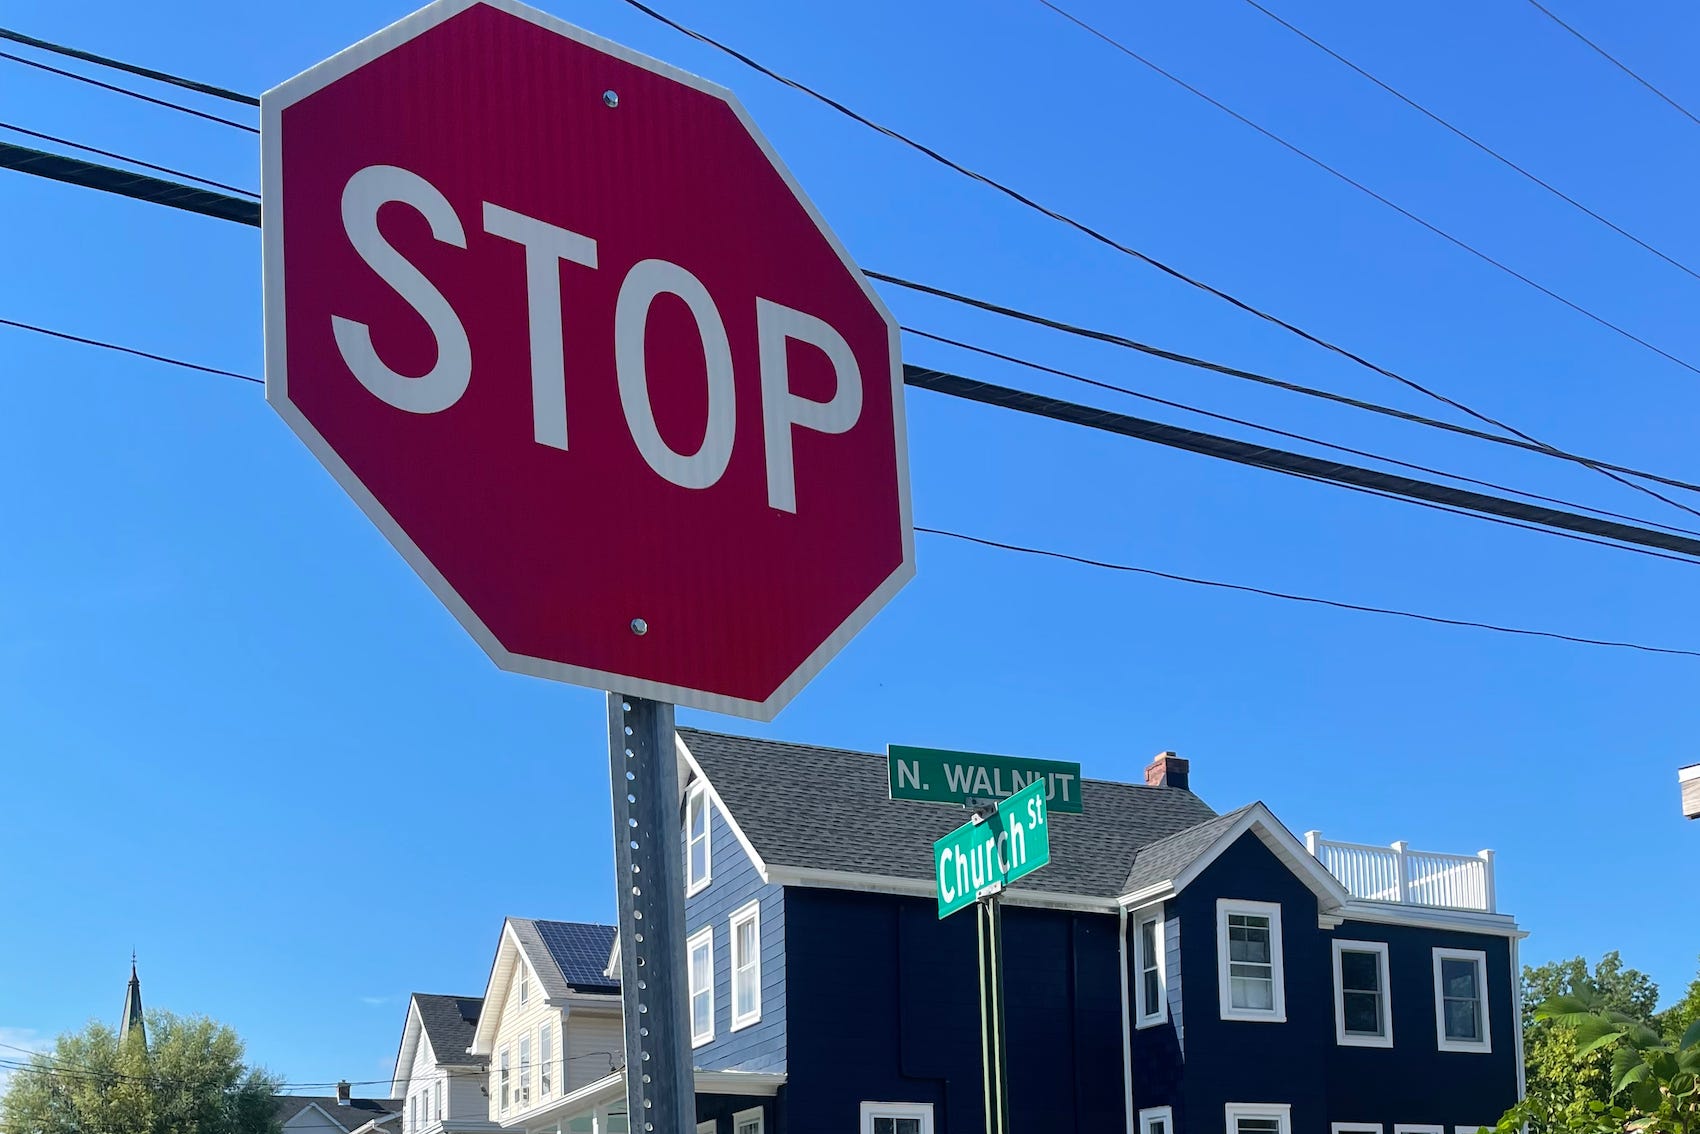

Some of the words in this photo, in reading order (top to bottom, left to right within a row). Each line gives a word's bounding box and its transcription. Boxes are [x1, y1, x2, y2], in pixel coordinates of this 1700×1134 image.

[331, 165, 863, 515] STOP
[897, 759, 930, 791] N.
[939, 812, 1026, 904] Church
[1027, 794, 1043, 830] St
